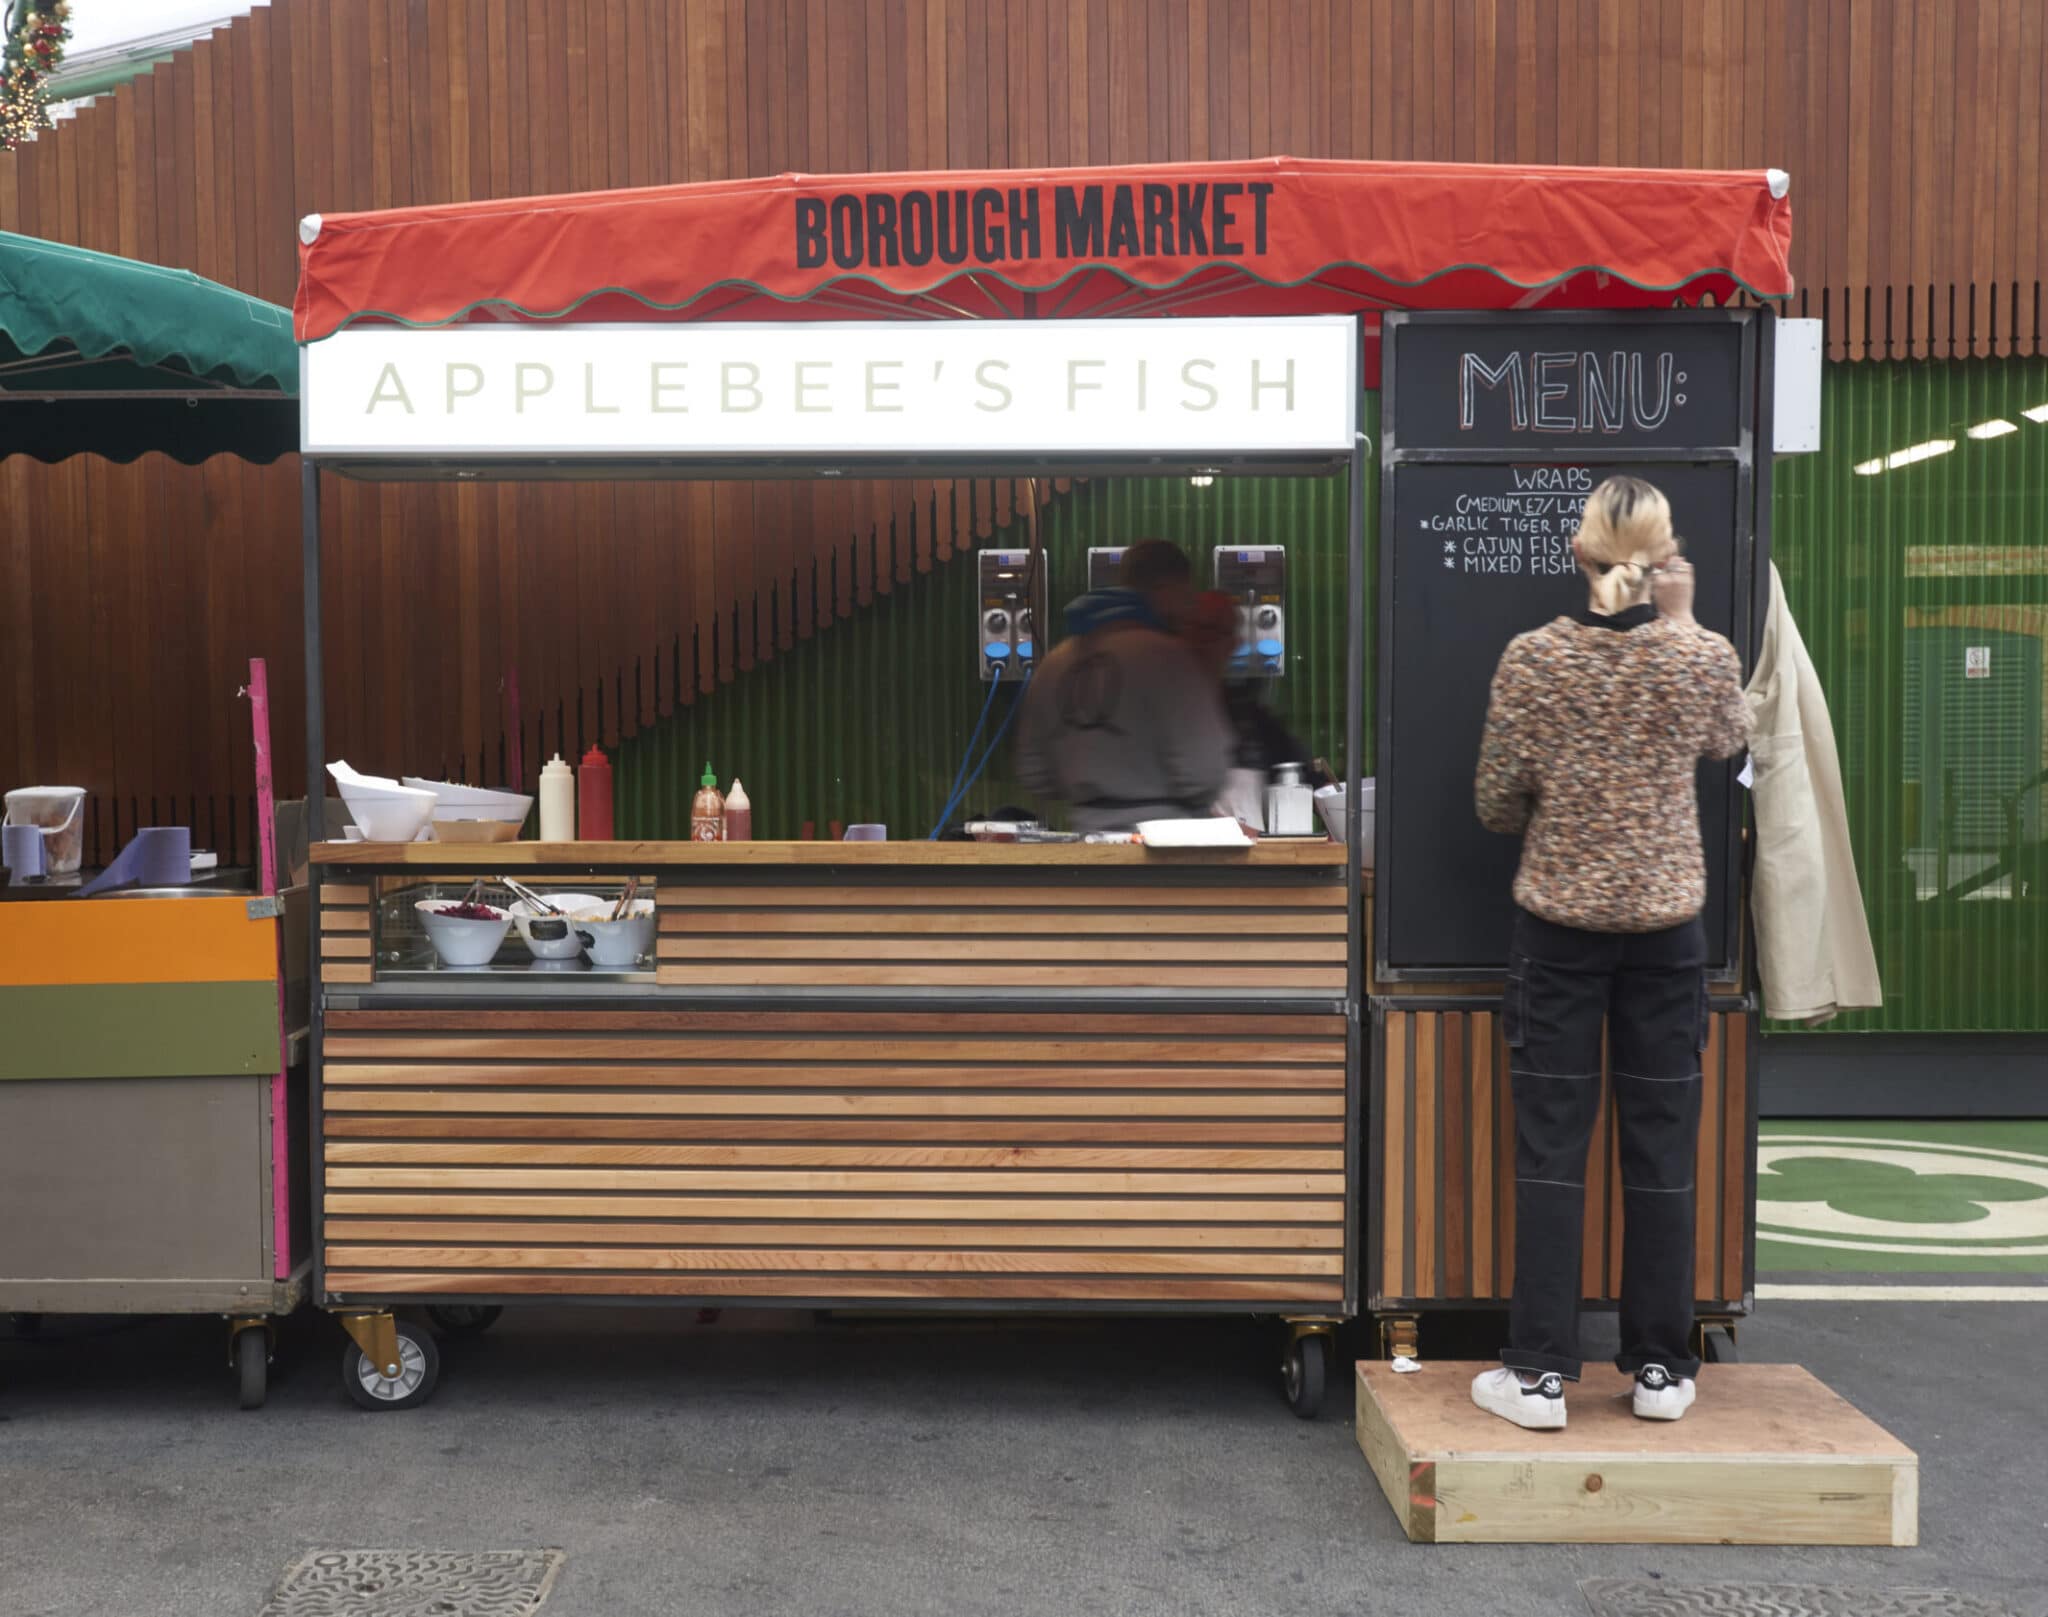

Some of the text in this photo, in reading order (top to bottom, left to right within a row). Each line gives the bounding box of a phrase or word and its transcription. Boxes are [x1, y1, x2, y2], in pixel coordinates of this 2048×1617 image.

[796, 182, 1274, 269] BOROUGH MARKET
[366, 358, 1296, 415] APPLEBEE'S FISH
[1459, 350, 1688, 433] MENU:
[1514, 467, 1593, 490] WRAPS
[1431, 515, 1489, 531] GARLIC
[1500, 517, 1552, 534] TIGER
[1463, 535, 1576, 555] CAJUN FISH
[1464, 555, 1577, 575] MIXED FISH
